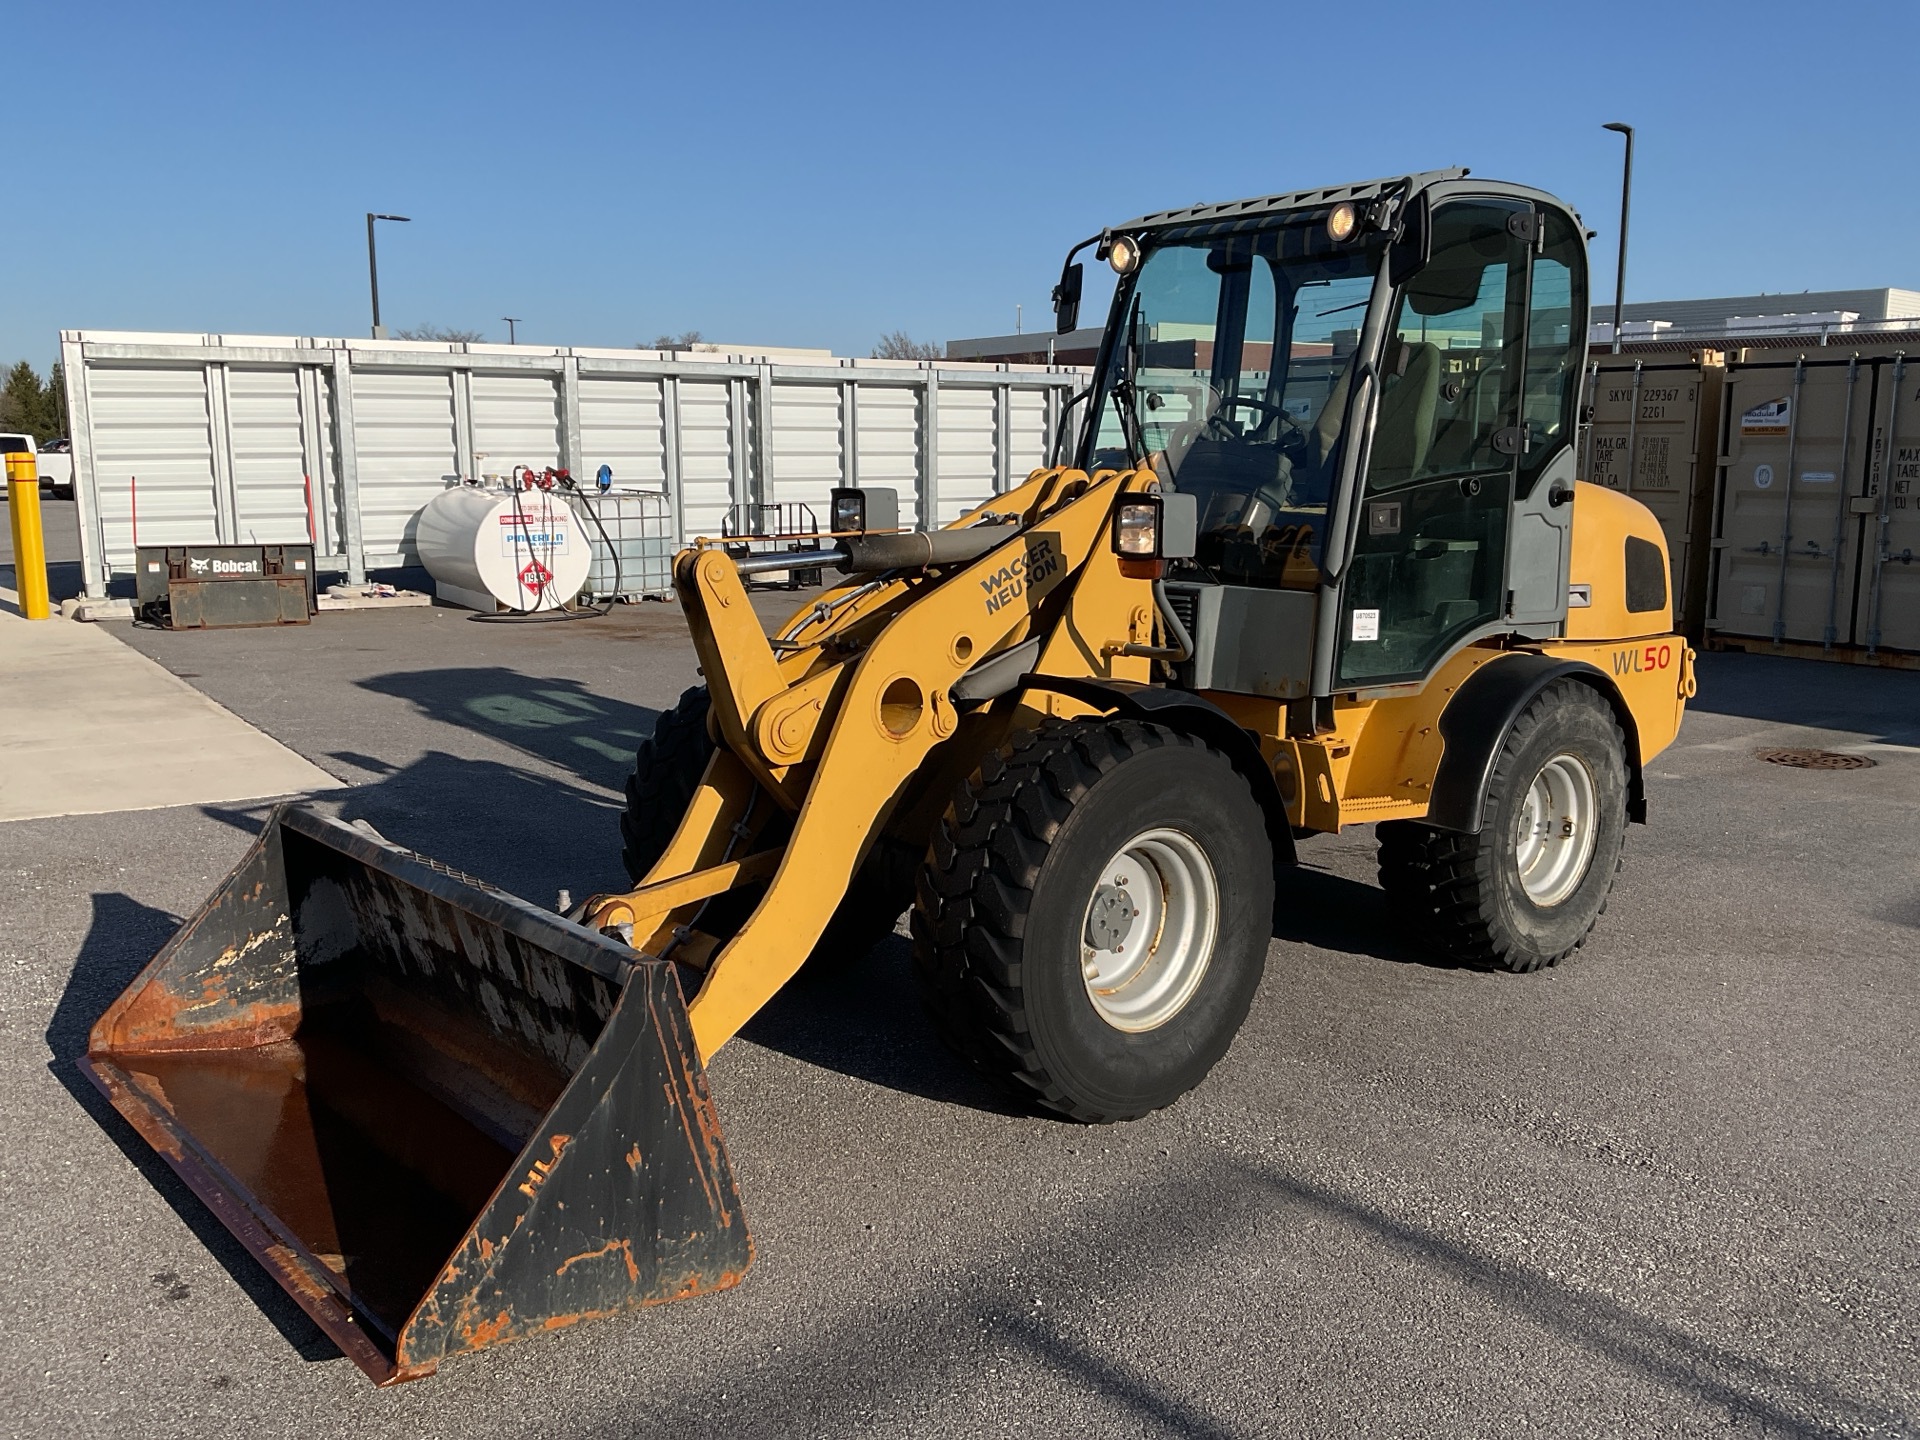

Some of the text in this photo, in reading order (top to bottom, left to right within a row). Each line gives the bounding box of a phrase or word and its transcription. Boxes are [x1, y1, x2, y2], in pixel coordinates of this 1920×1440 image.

[1609, 388, 1695, 402] SKYU 229367 8
[1642, 406, 1665, 418] 22G1
[1596, 449, 1614, 461] TARE
[1594, 461, 1610, 473] NET
[1896, 463, 1920, 478] TARE
[1593, 474, 1604, 485] CU
[1608, 474, 1618, 486] CA
[1894, 480, 1910, 494] NET
[1895, 496, 1906, 509] CU
[212, 560, 258, 573] Bobcat
[980, 540, 1053, 594] WACKER
[985, 556, 1058, 616] NEUSON
[1613, 645, 1671, 676] WL50
[518, 1134, 572, 1199] HLA
